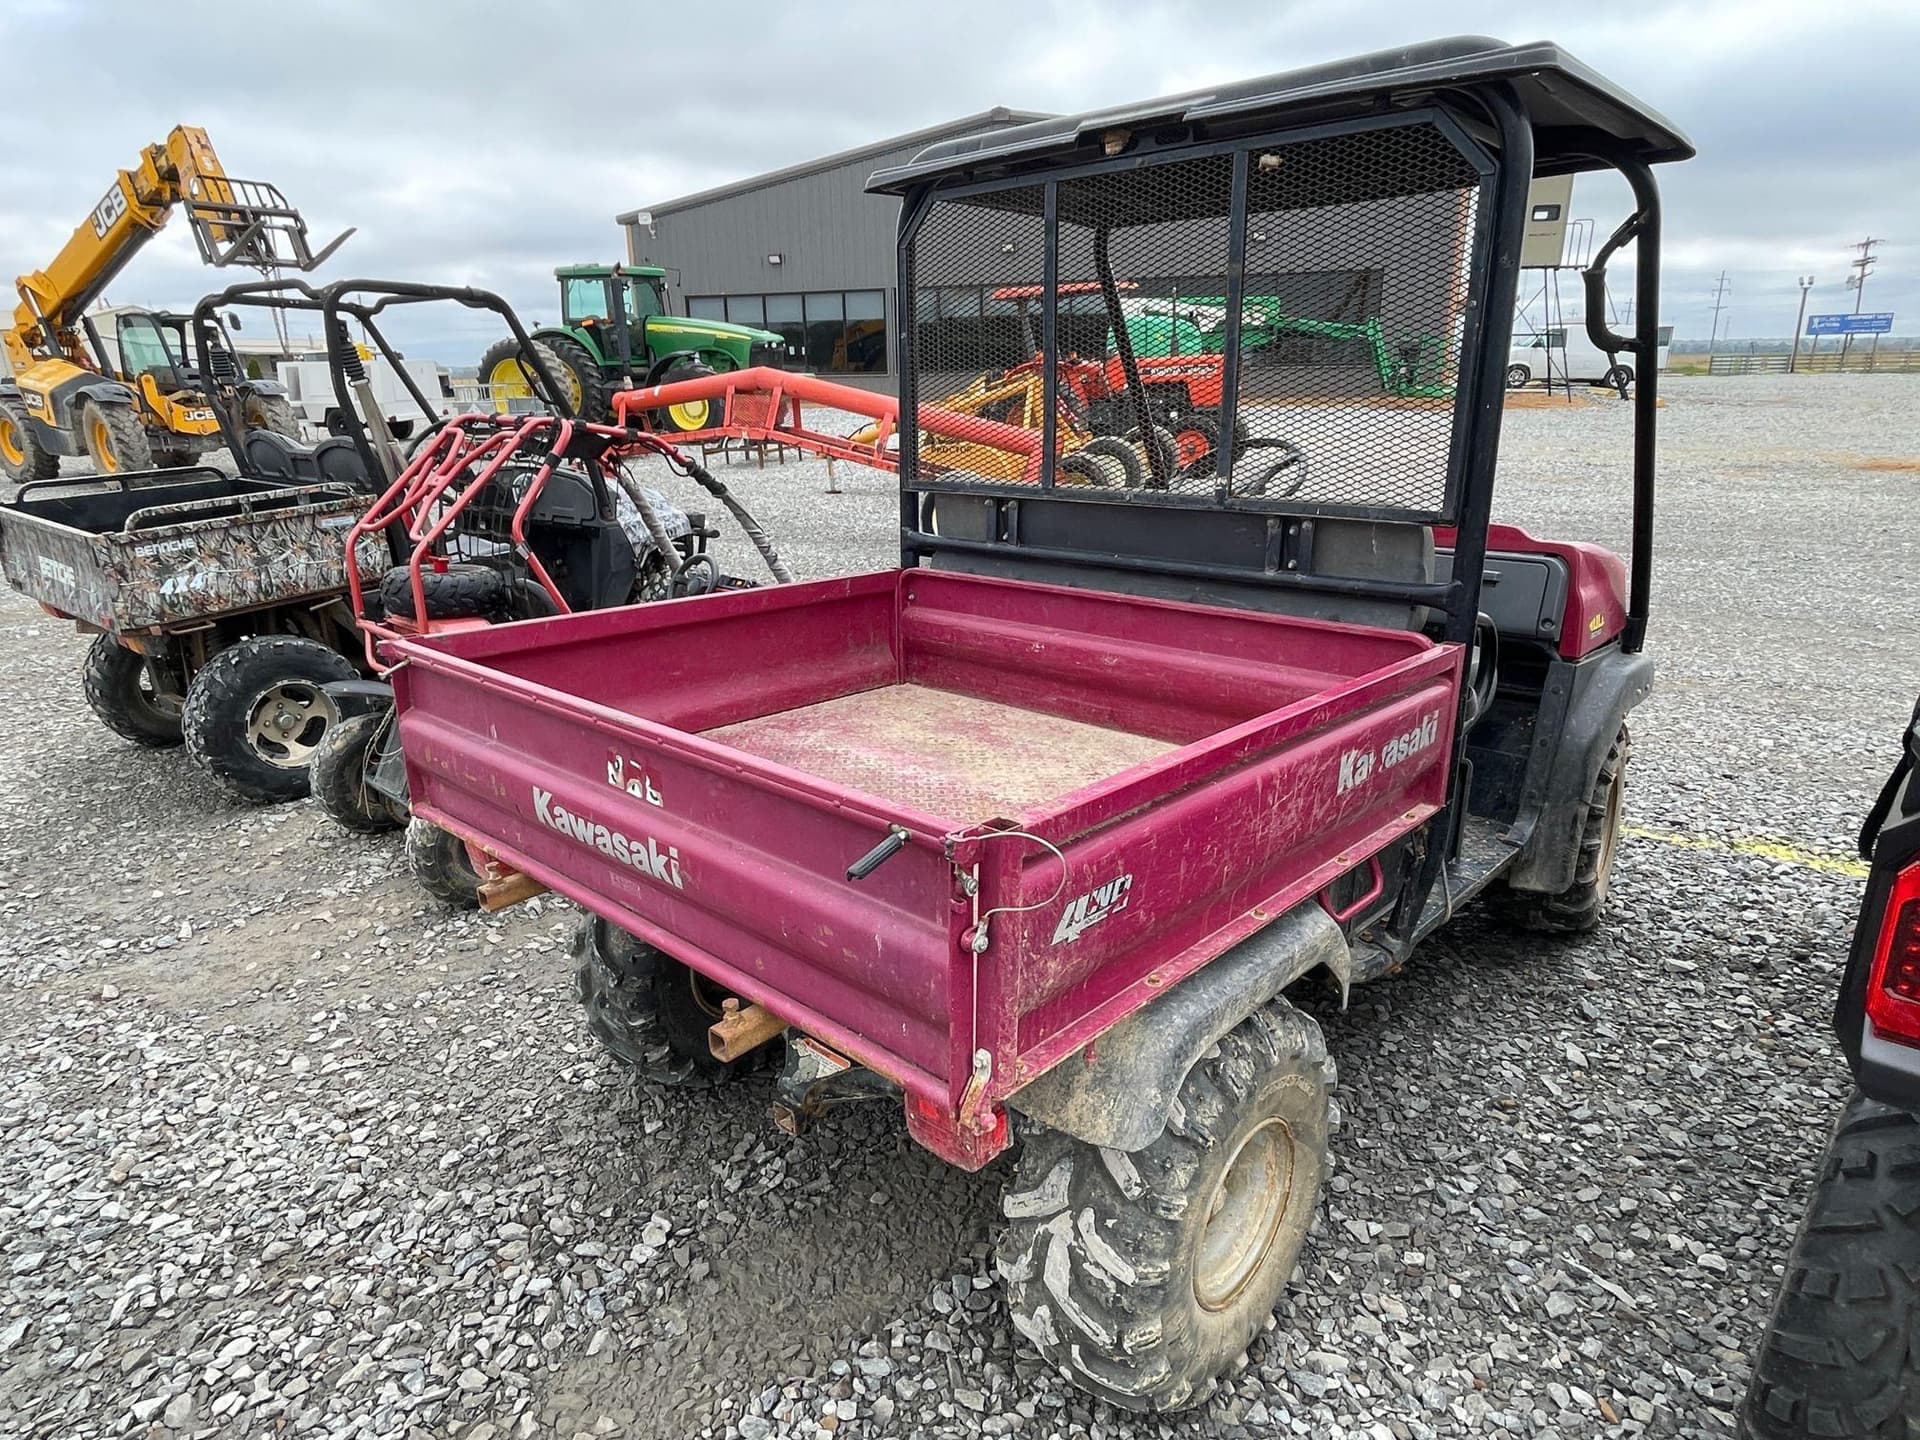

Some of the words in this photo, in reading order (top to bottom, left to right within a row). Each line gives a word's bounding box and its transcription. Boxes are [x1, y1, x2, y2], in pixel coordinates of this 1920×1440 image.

[90, 183, 128, 239] JCB
[184, 410, 216, 420] JCB
[1337, 709, 1440, 796] Kaasaki
[532, 785, 683, 890] Kawasaki
